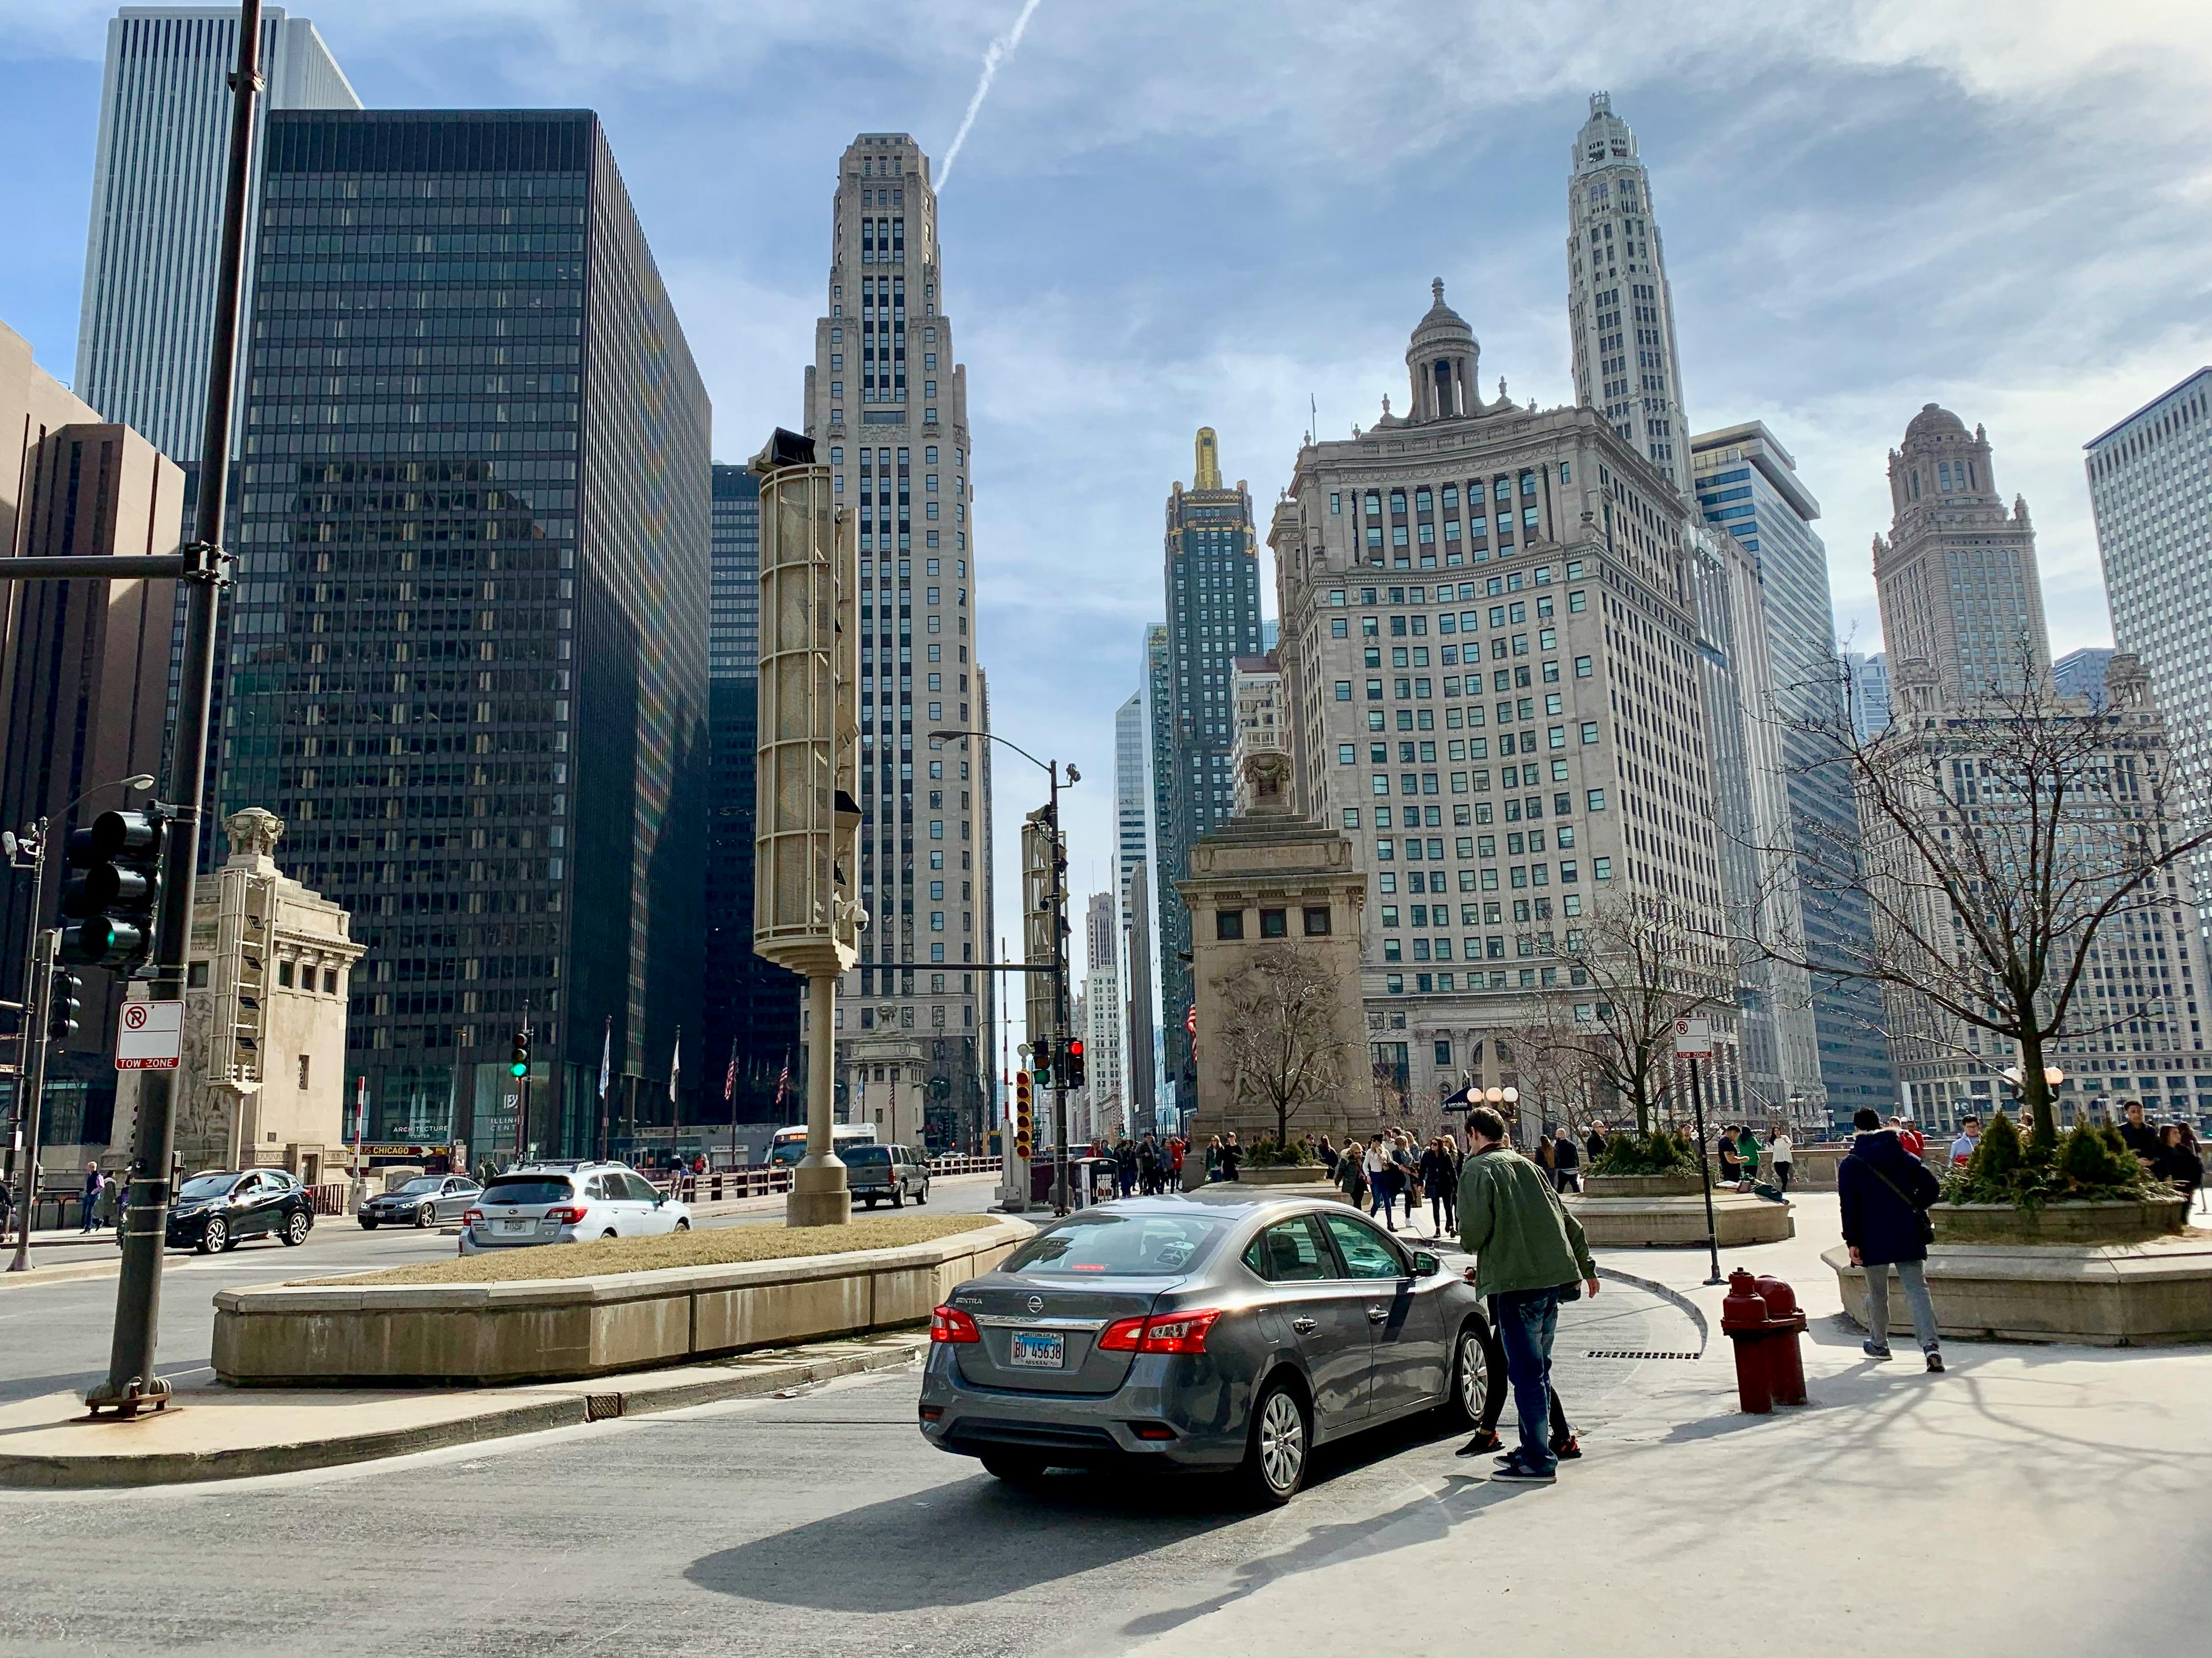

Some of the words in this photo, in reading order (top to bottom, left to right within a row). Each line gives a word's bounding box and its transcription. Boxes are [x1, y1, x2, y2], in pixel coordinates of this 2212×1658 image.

[120, 1060, 141, 1068] TOW
[146, 1058, 174, 1067] ZONE
[1015, 1342, 1027, 1358] BU
[1032, 1342, 1061, 1359] 45638
